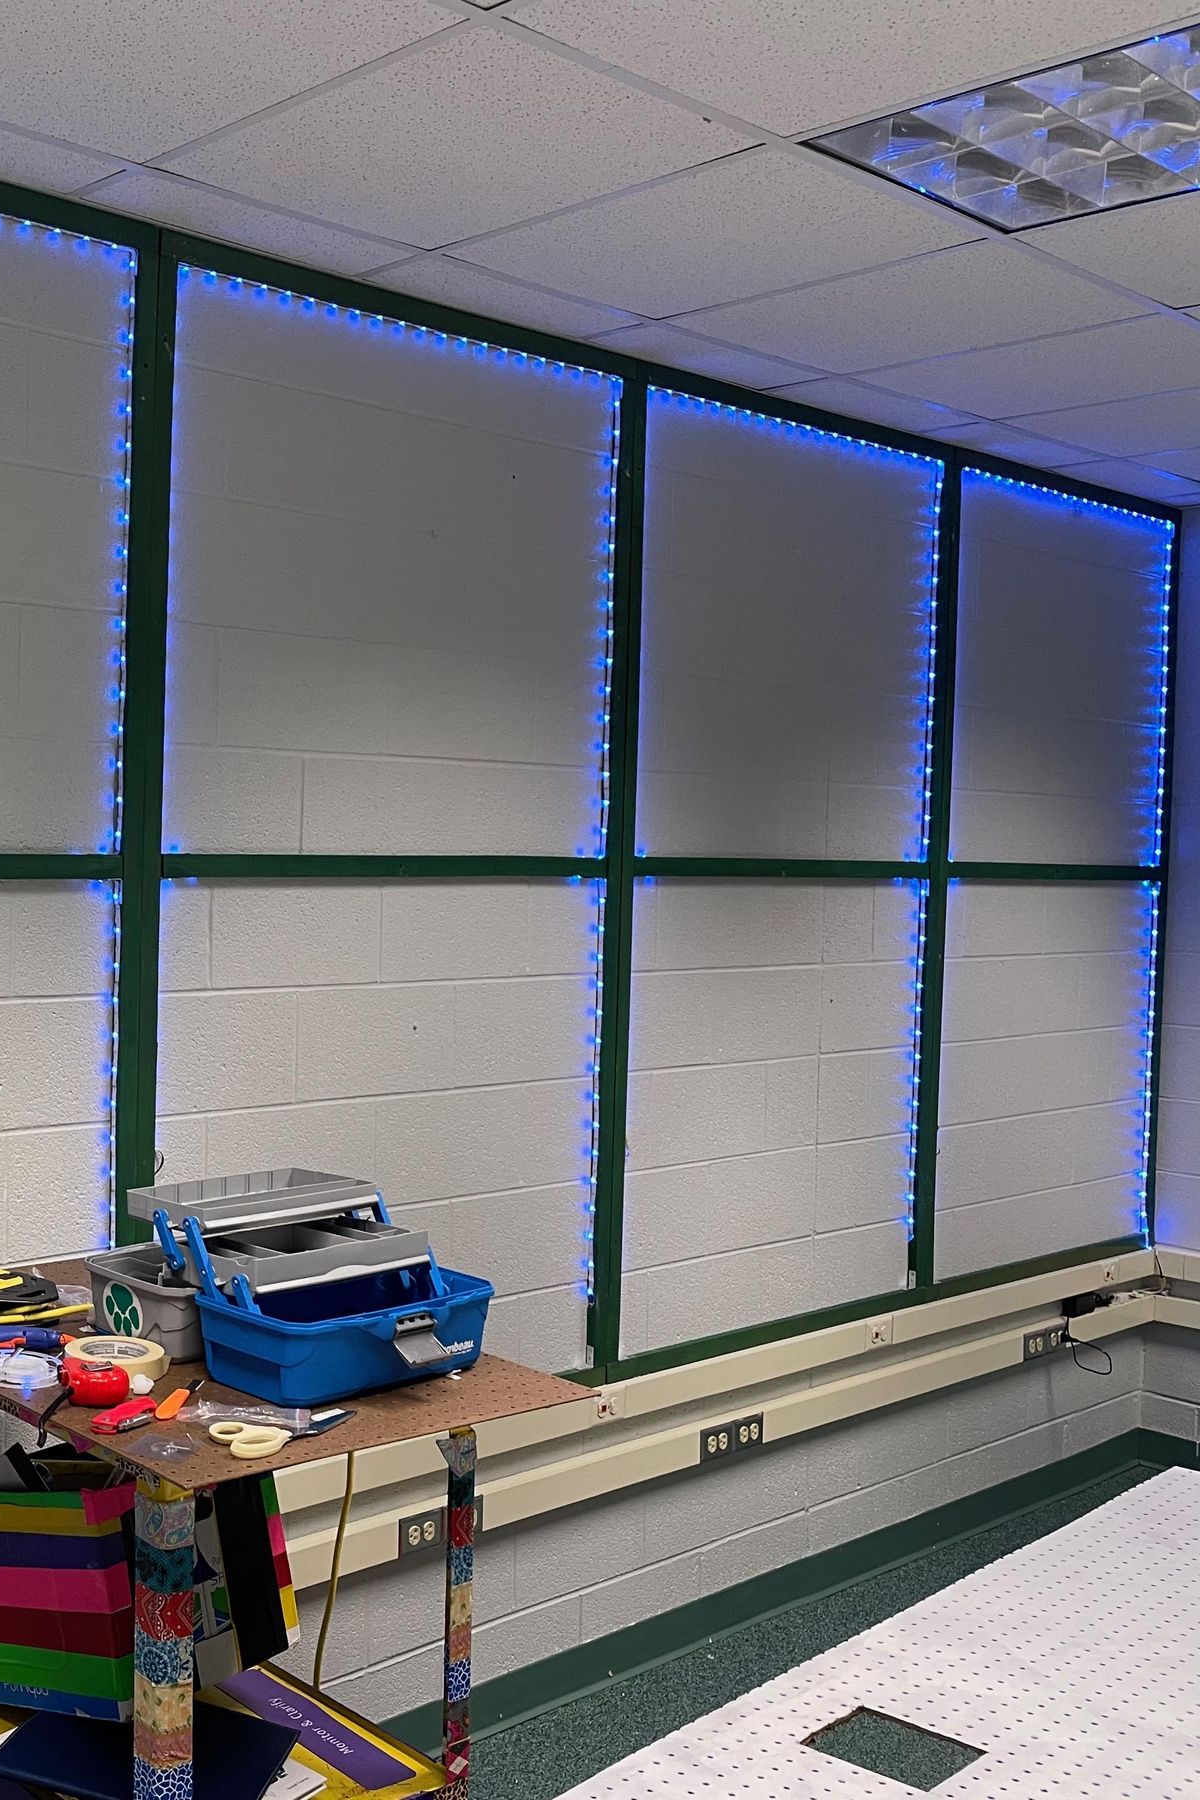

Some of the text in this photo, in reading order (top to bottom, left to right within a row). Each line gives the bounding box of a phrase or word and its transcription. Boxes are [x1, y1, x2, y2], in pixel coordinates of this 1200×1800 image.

[268, 1697, 354, 1755] Monitor & Clarify
